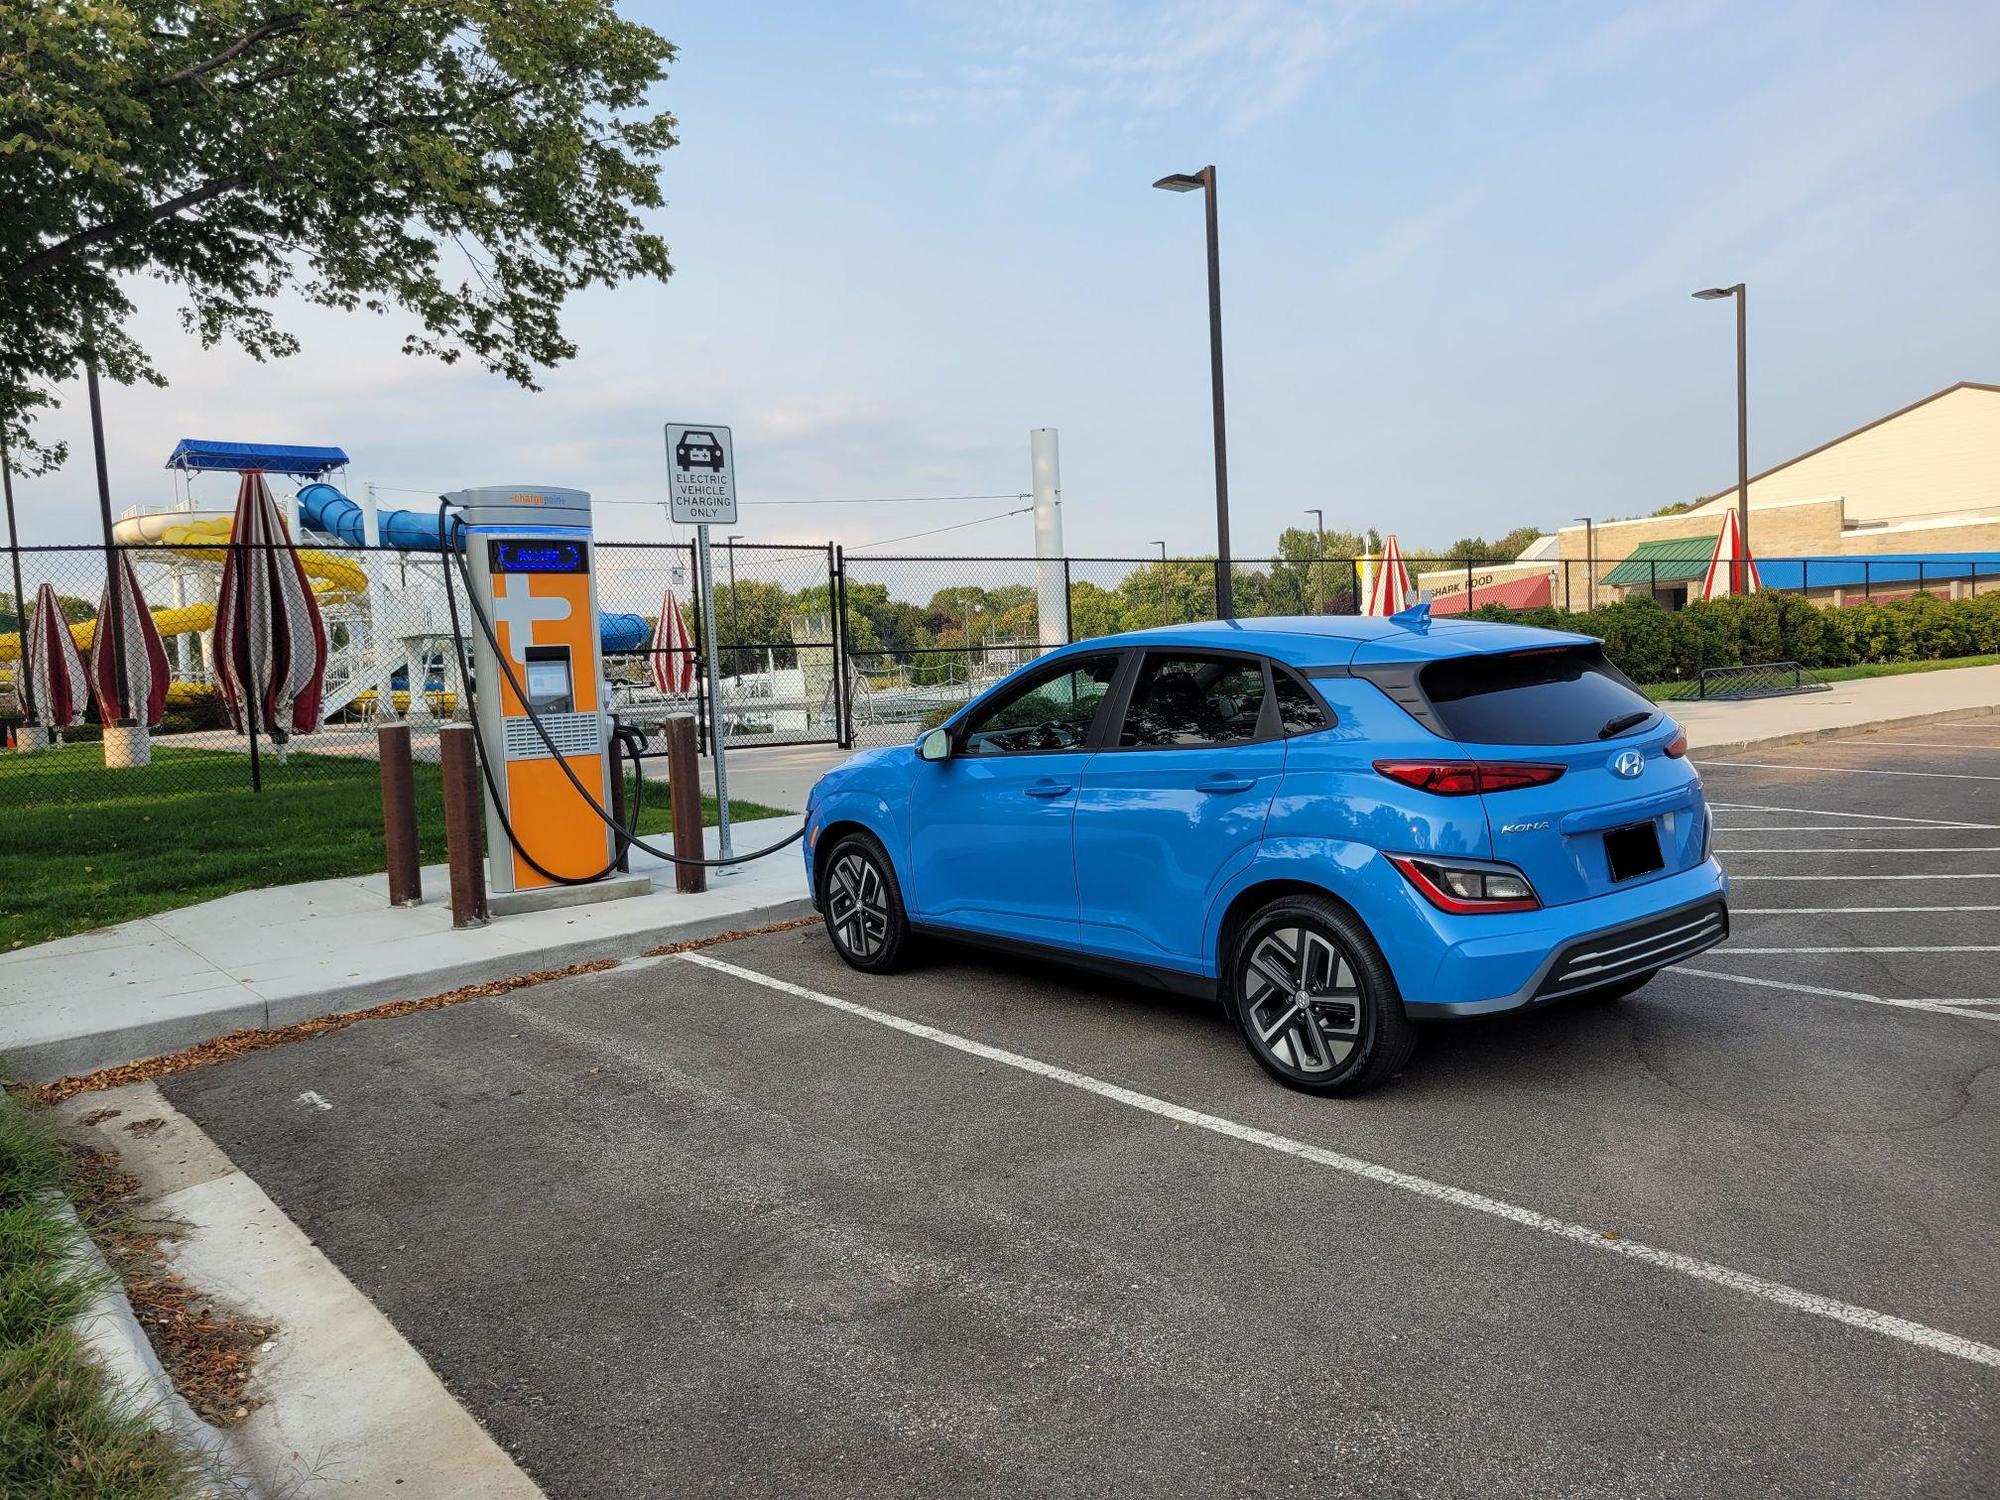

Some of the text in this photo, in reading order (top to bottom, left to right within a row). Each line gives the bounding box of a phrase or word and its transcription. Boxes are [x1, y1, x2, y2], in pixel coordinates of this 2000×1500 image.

[676, 474, 728, 485] ELECTRIC
[680, 486, 726, 496] VEHICLE
[676, 497, 731, 507] CHARGING
[690, 508, 719, 518] ONLY
[1501, 822, 1549, 834] KONA
